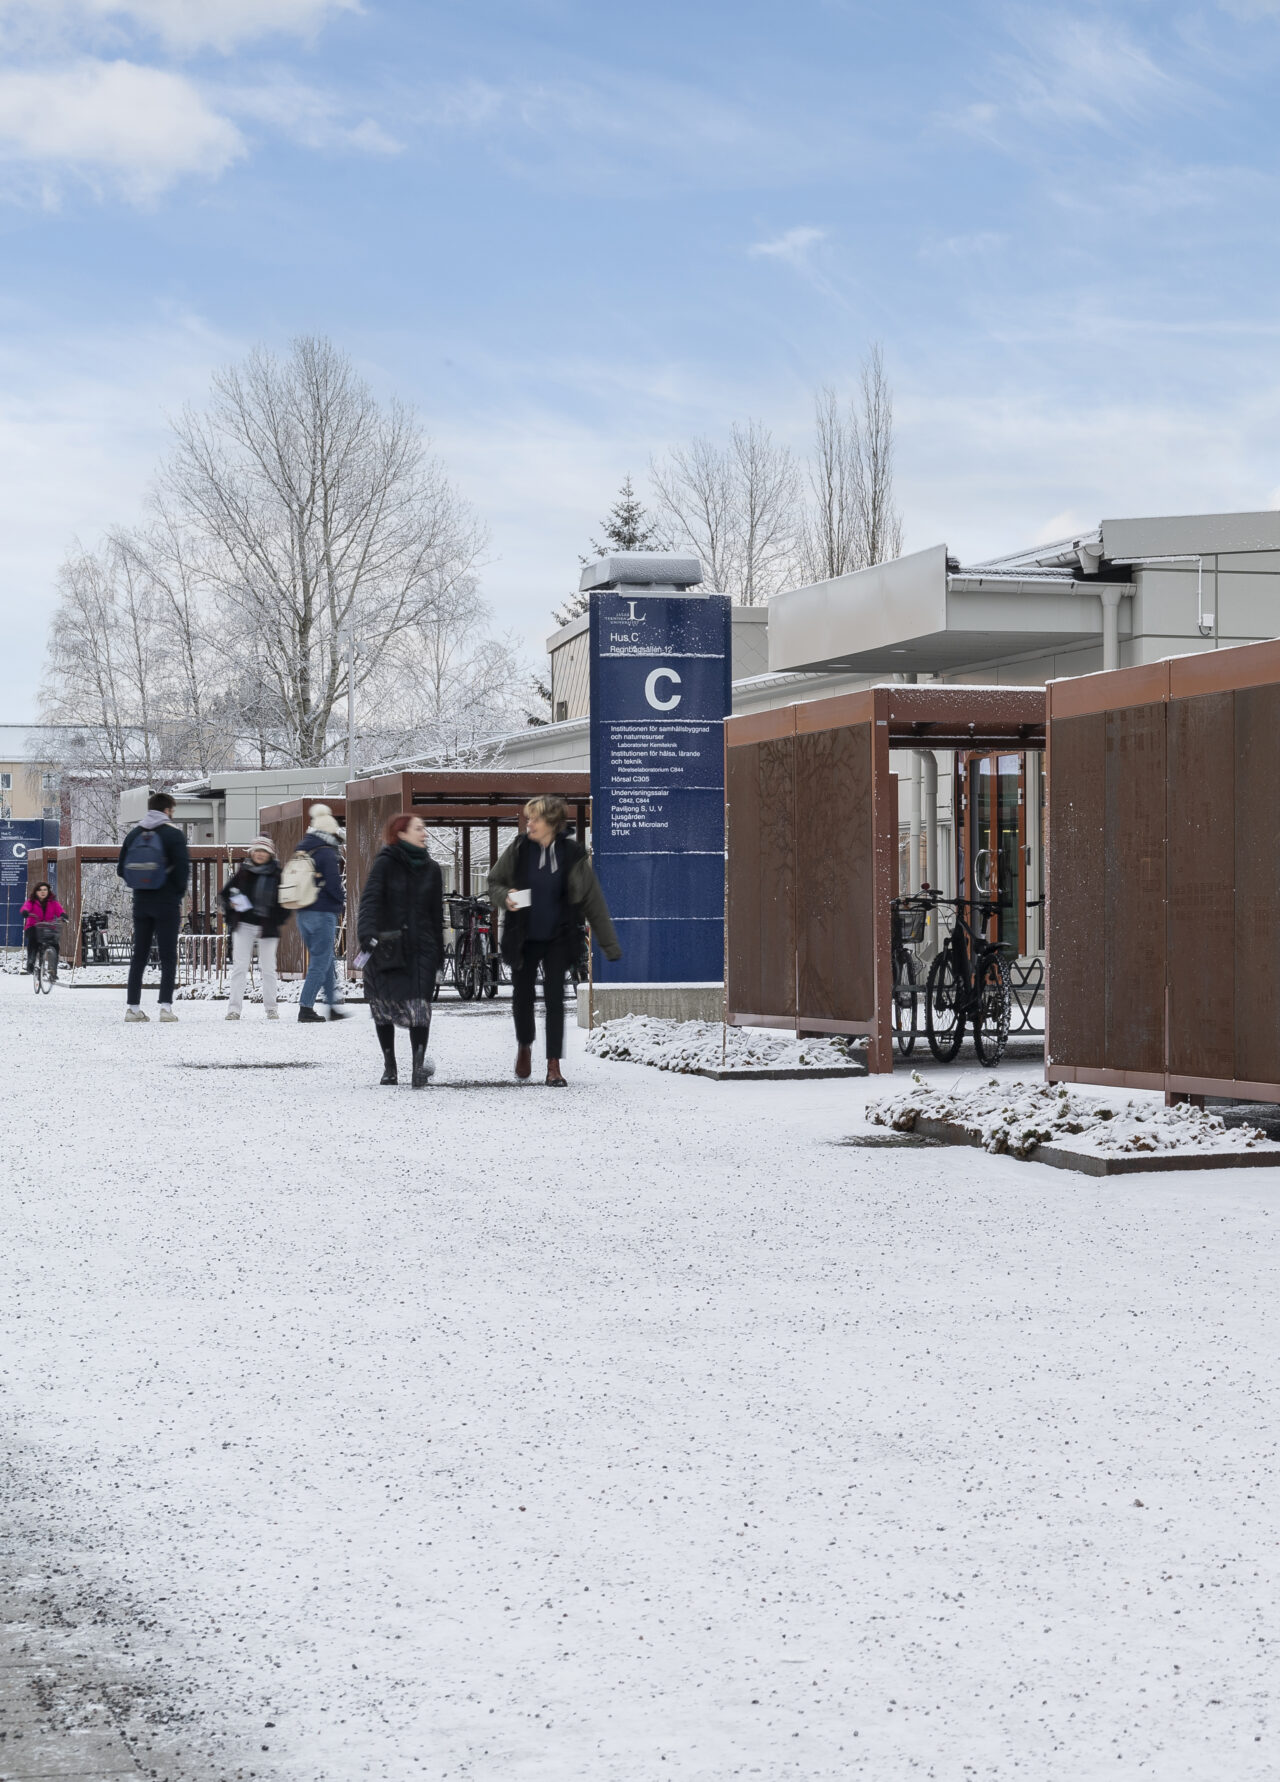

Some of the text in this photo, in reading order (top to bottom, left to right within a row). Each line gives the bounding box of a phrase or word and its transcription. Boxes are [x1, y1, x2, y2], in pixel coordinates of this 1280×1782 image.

[610, 632, 639, 642] Hus C
[664, 645, 673, 653] 12
[644, 667, 682, 711] C
[659, 725, 710, 734] samhällsbyggnad
[659, 750, 678, 758] hälsa,
[611, 789, 670, 797] Undervisningssalar
[611, 805, 640, 813] Paviljong
[611, 813, 646, 821] Ljusgården
[611, 821, 631, 829] Hyllan
[12, 842, 26, 858] C
